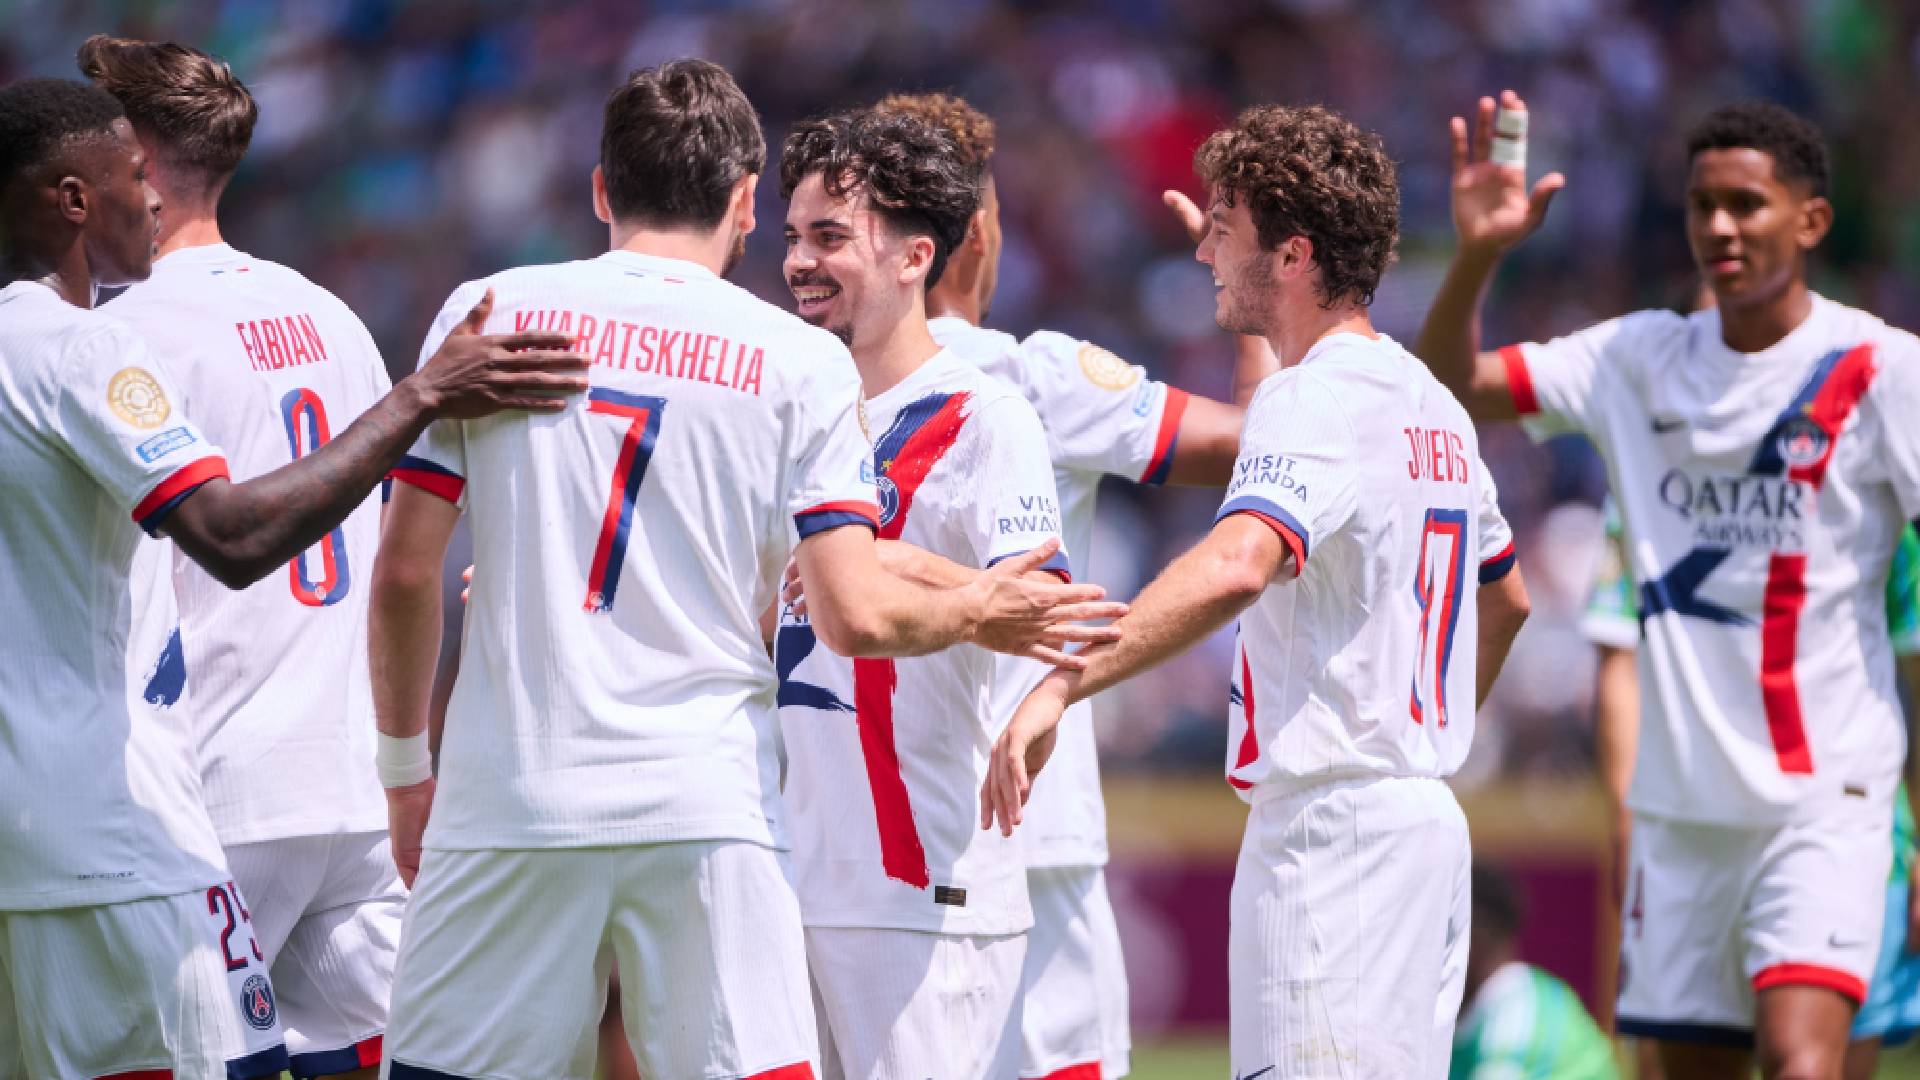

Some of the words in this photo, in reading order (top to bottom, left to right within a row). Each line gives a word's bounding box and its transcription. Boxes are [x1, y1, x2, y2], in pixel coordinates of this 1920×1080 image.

[236, 313, 328, 371] FABIAN
[1239, 454, 1297, 473] VISIT
[583, 386, 668, 614] 7
[1659, 467, 1802, 518] QATAR
